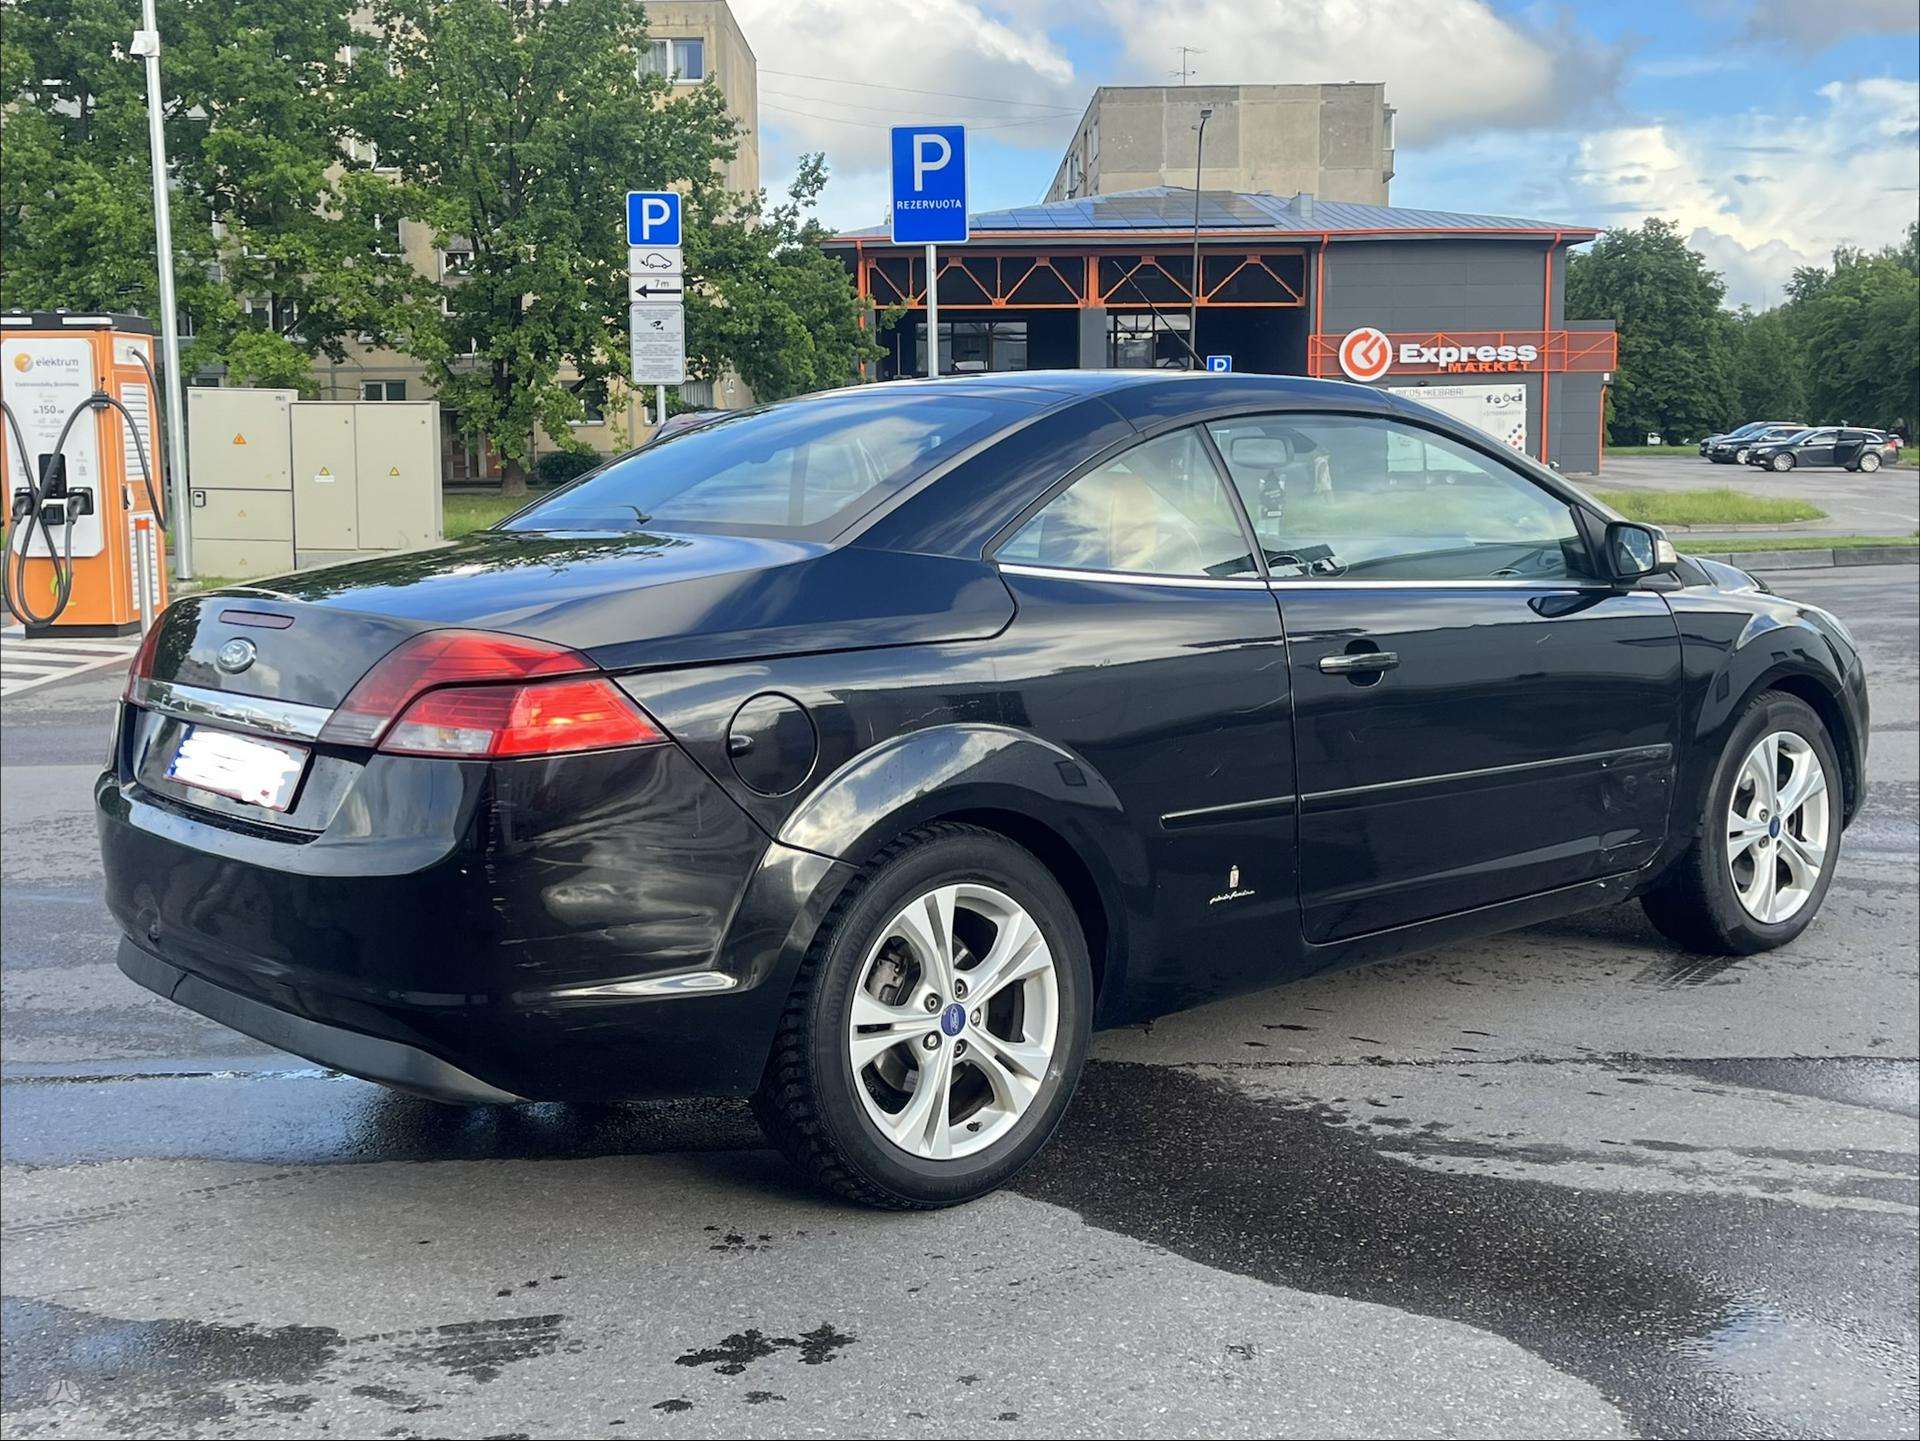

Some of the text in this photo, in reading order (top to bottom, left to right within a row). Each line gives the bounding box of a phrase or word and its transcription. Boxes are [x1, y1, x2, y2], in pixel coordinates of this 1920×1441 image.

[914, 134, 952, 191] P
[897, 199, 962, 210] REZERVUOTA
[642, 198, 670, 240] P
[1400, 343, 1538, 367] Express
[1448, 361, 1530, 373] MARKET
[40, 405, 56, 414] 150
